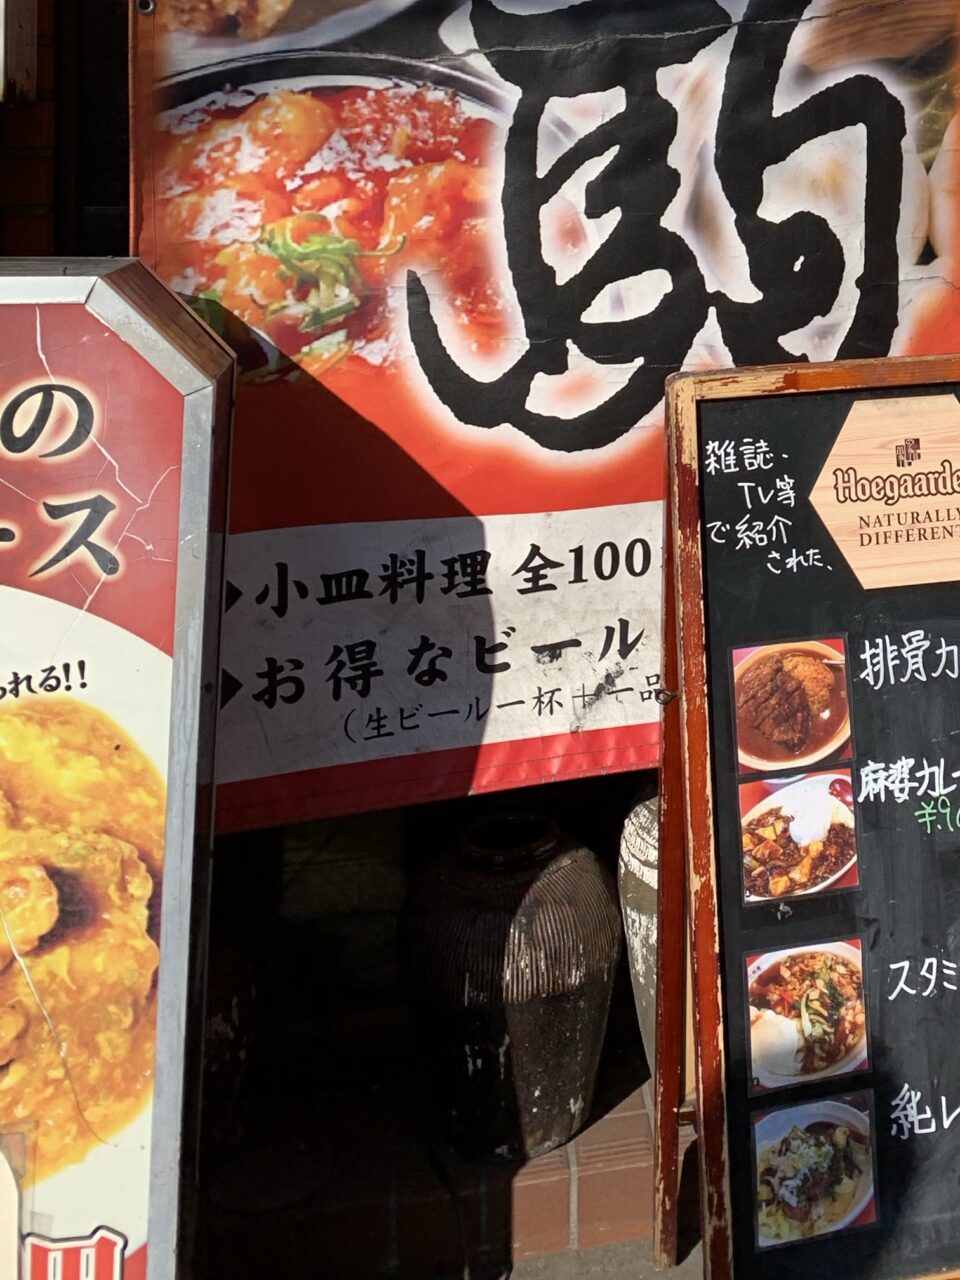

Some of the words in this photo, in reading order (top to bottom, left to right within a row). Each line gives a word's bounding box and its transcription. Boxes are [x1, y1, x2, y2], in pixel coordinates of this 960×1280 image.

[0, 383, 95, 459] の
[737, 474, 797, 509] TV等
[706, 513, 793, 551] で紹介
[254, 549, 494, 619] 小皿料理
[510, 537, 663, 596] 全100
[0, 659, 89, 701] れる!!
[251, 617, 646, 711] お得なビール
